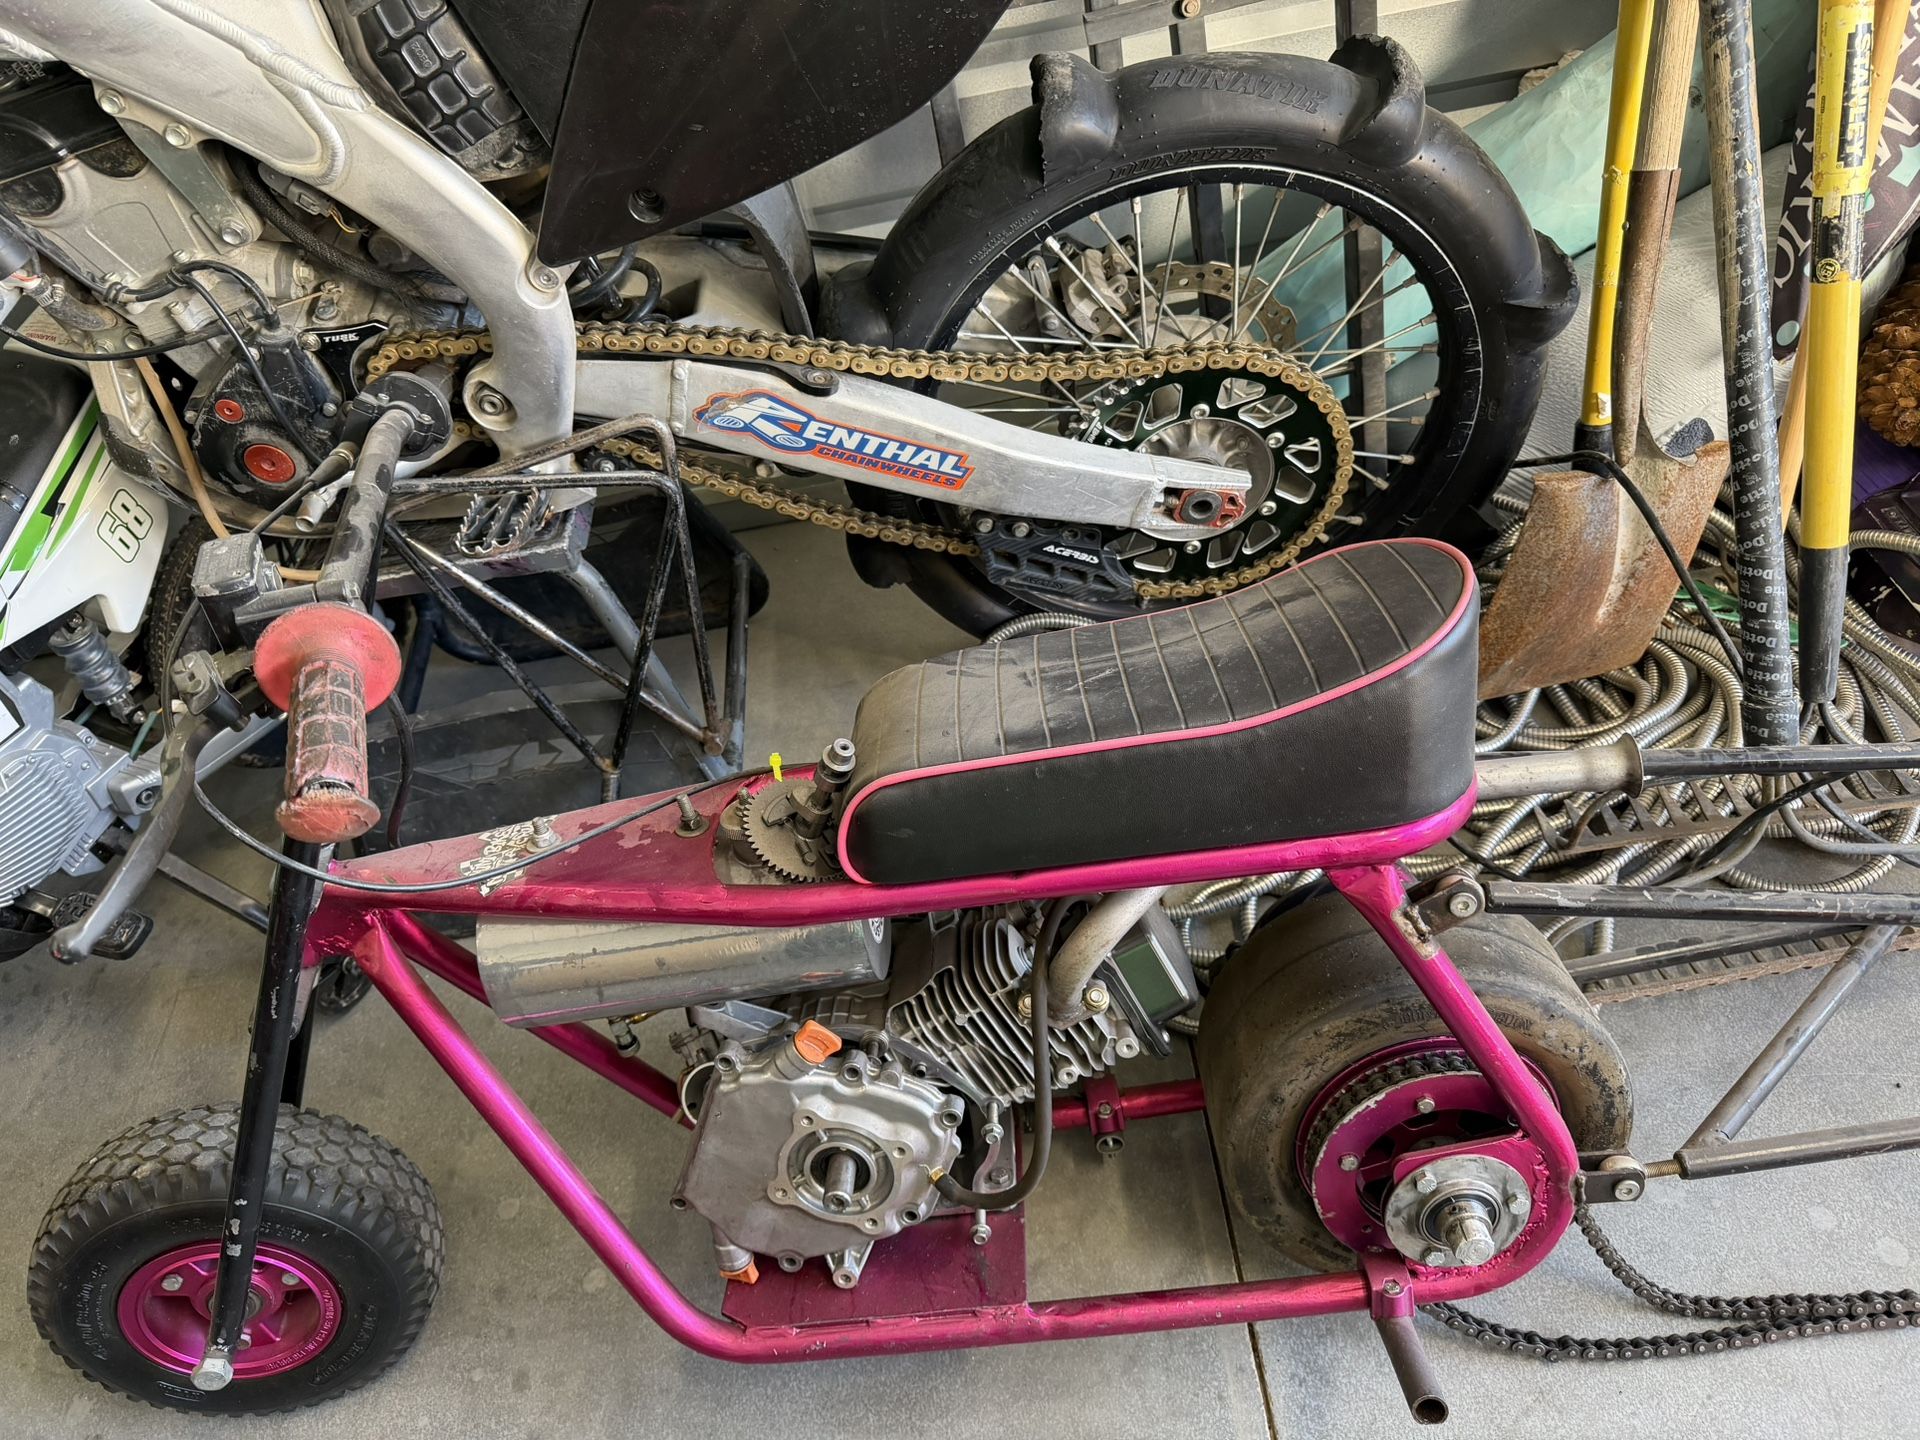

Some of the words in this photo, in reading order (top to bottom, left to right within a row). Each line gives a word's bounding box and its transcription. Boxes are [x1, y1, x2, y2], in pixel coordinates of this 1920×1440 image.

[1847, 32, 1872, 157] STANLEY
[323, 333, 359, 343] TUSK
[817, 447, 958, 487] CHAINWHEELS
[97, 488, 154, 563] 68
[1042, 545, 1100, 564] ACERBIS
[1747, 668, 1788, 683] Dottie
